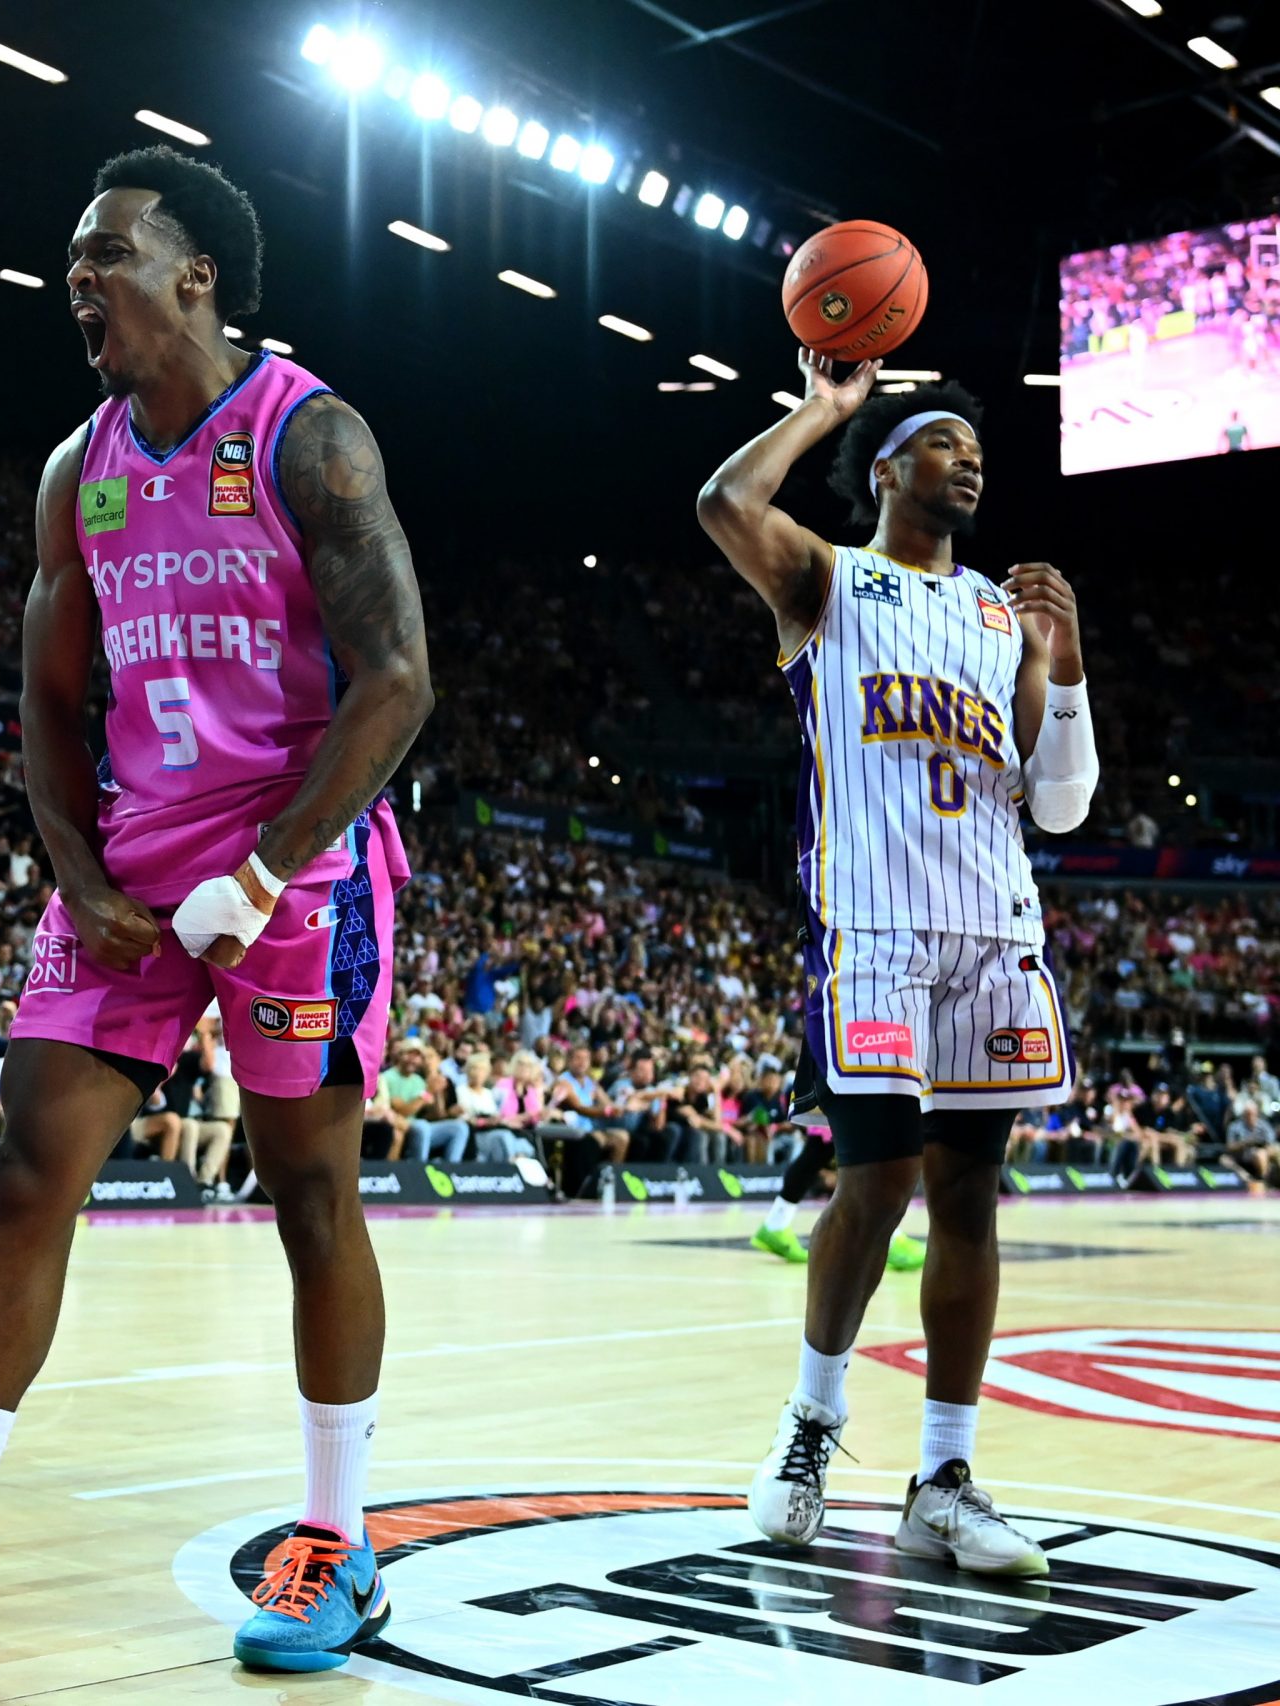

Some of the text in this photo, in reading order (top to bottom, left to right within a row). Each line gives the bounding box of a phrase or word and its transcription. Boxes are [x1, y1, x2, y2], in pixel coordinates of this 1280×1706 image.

[222, 442, 248, 461] NBL
[215, 485, 248, 493] HUNGRY
[134, 548, 278, 589] SPORT
[854, 589, 902, 605] HOSTPLUS
[144, 677, 200, 770] 5
[858, 671, 1006, 770] KINGS
[926, 751, 968, 819] 0
[34, 936, 67, 959] NE
[29, 960, 66, 985] ON
[258, 1005, 280, 1027] NBL
[295, 1012, 330, 1020] HUNGRY
[852, 1030, 910, 1049] Carma
[992, 1038, 1013, 1053] NBL
